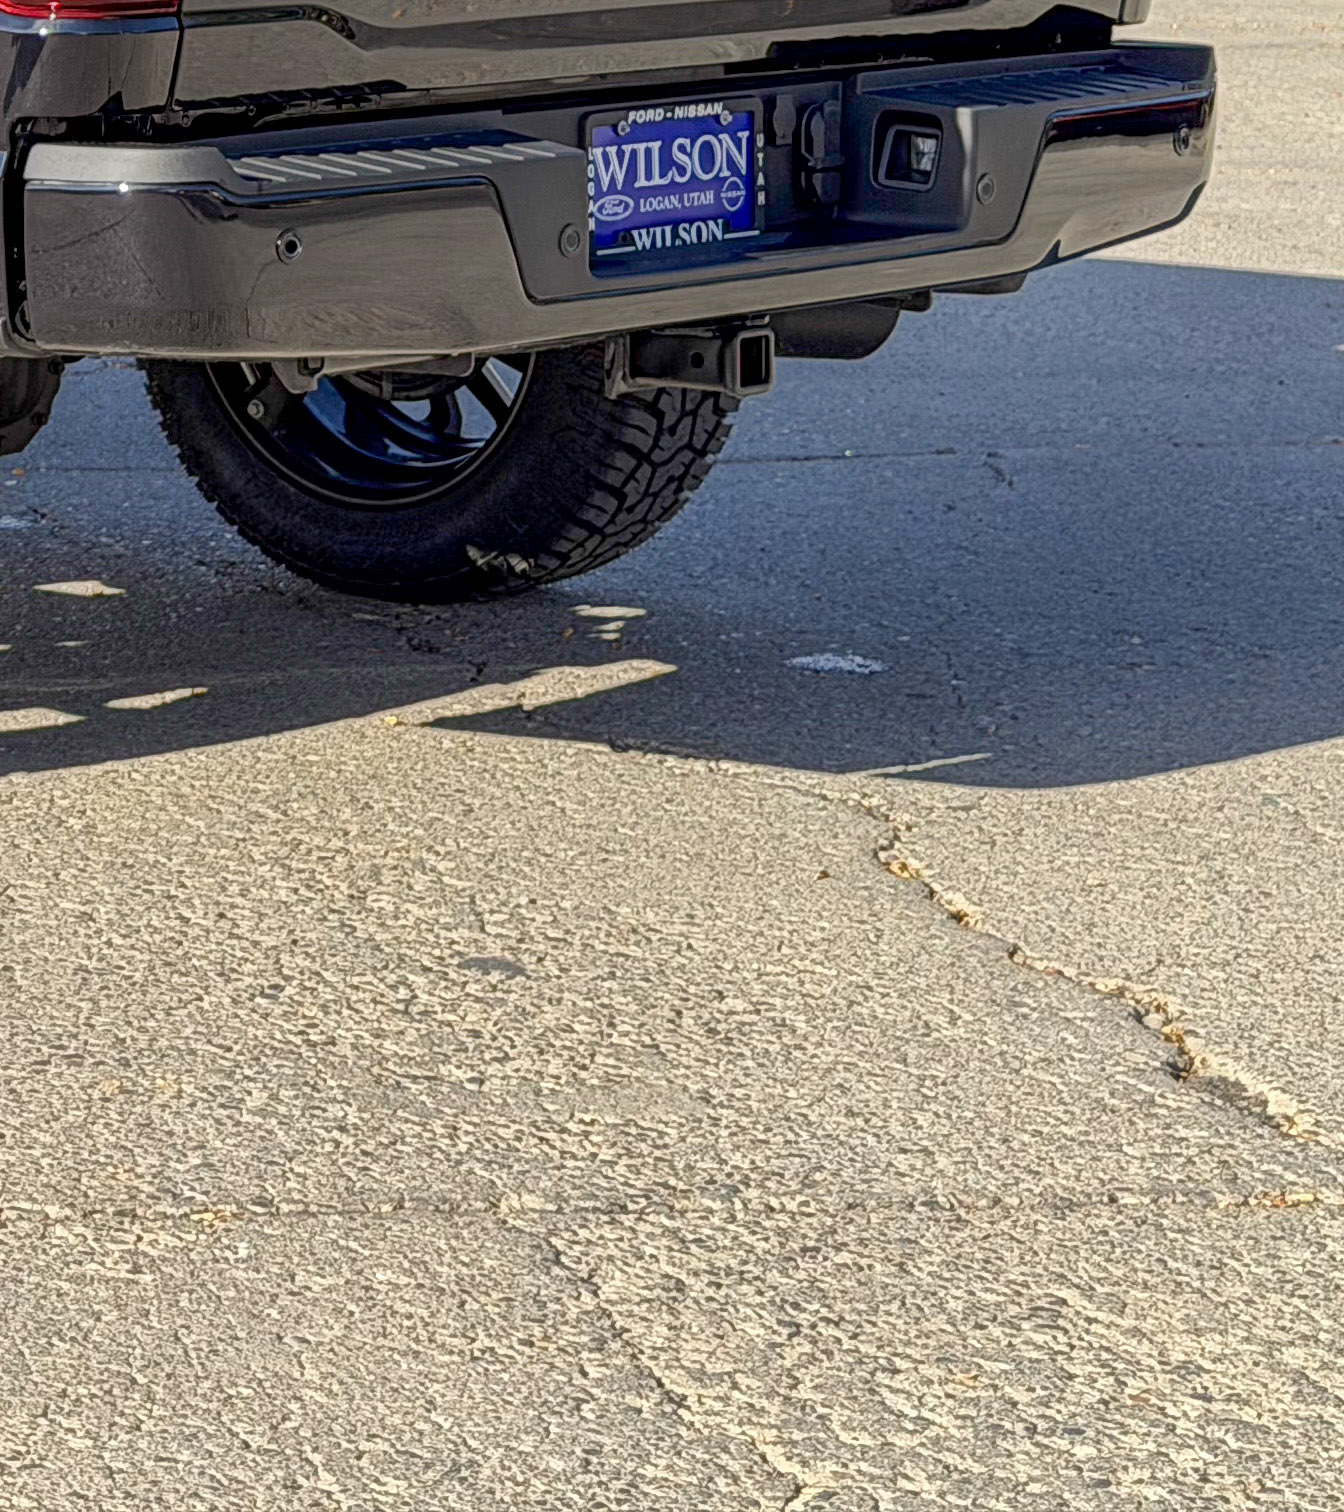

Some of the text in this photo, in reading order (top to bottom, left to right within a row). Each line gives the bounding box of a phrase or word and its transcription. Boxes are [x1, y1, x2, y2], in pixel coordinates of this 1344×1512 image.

[592, 130, 750, 192] WILSON
[756, 133, 766, 206] UTAH
[639, 190, 715, 214] LOGAN, UTAH
[631, 218, 724, 251] WILSON
